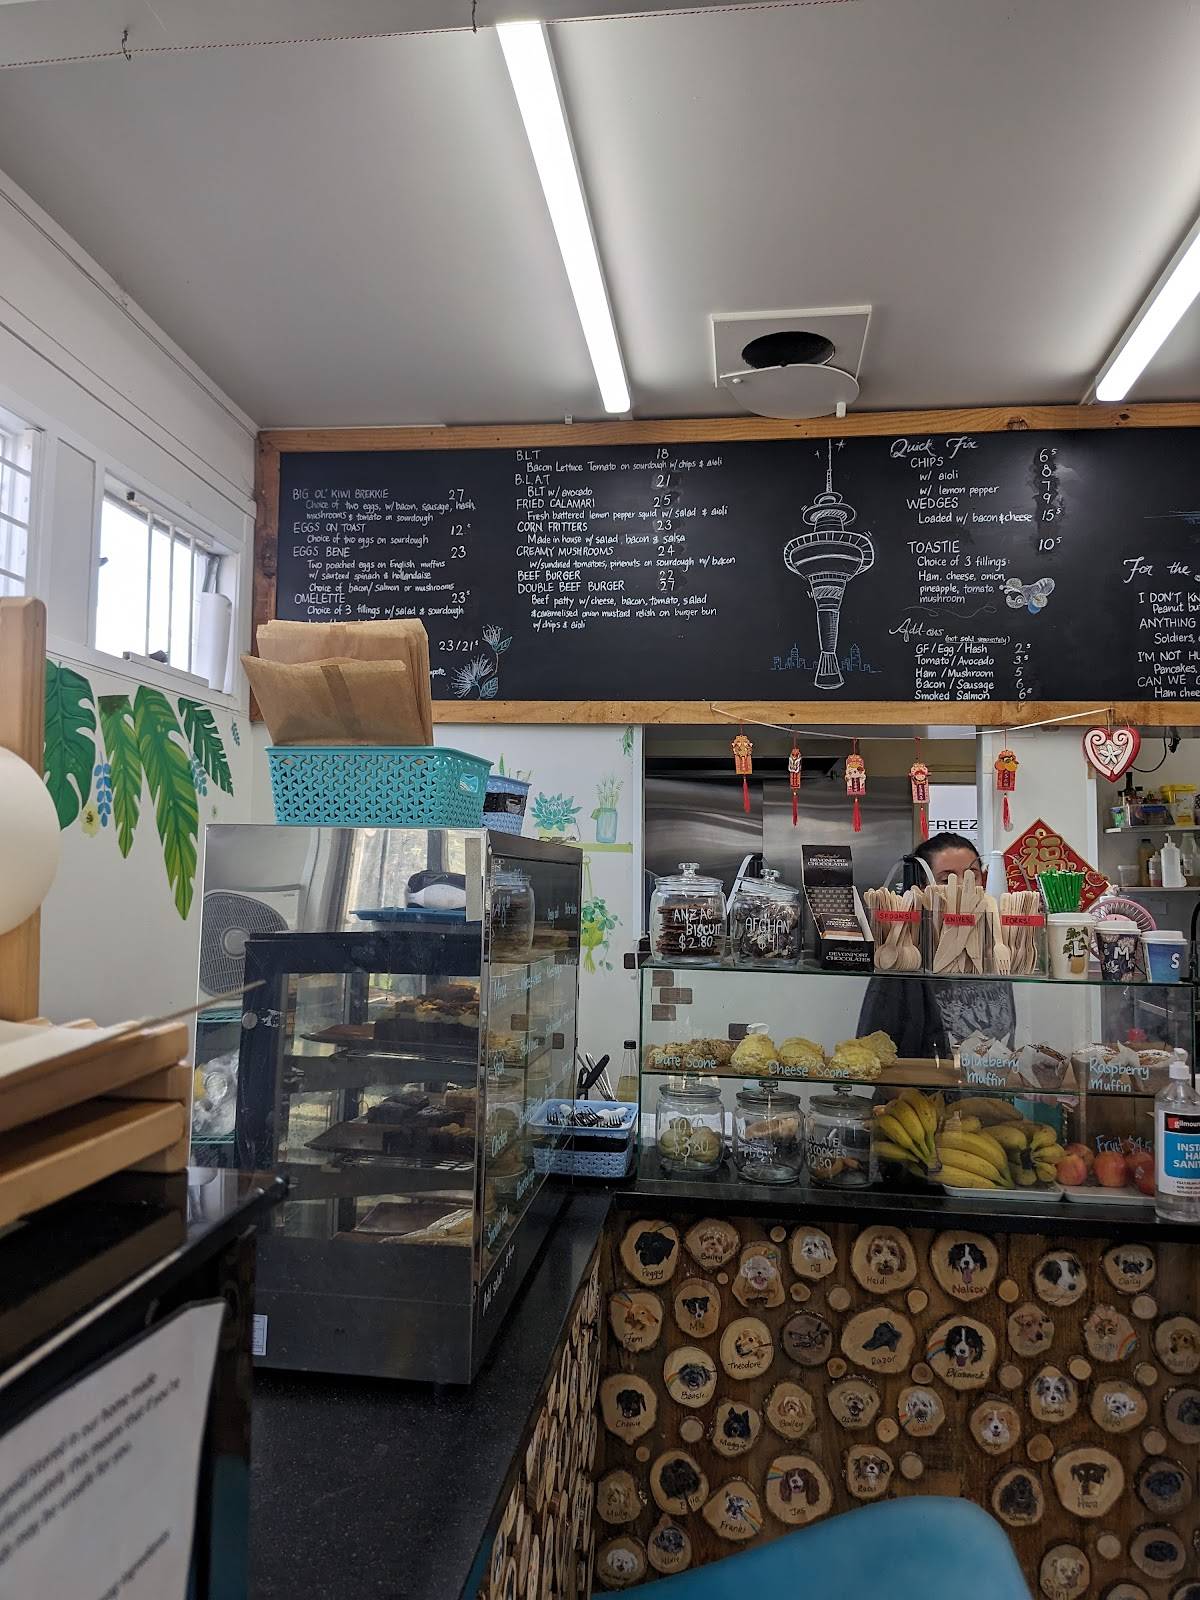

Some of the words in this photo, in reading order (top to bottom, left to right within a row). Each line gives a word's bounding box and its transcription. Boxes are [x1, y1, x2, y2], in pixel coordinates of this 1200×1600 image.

[890, 438, 936, 458] Quick
[946, 436, 979, 459] Fix
[657, 449, 669, 460] 18
[527, 460, 552, 473] Bacon
[556, 460, 583, 472] Lettuce
[588, 461, 616, 471] Tomato
[633, 459, 667, 471] sourdough
[707, 457, 723, 467] aioli
[910, 456, 944, 468] CHIPS
[919, 471, 931, 481] w/
[939, 470, 958, 480] aioli
[1041, 465, 1052, 477] 8
[657, 475, 670, 488] 21
[293, 489, 308, 500] BIG
[332, 490, 350, 498] KIWI
[355, 489, 388, 498] BREKKIE
[449, 489, 464, 502] 27
[528, 486, 545, 497] BLT
[920, 485, 932, 496] w/
[939, 484, 966, 494] lemon
[969, 485, 1000, 498] pepper
[1041, 481, 1051, 491] 7
[306, 500, 328, 509] Choice
[345, 502, 358, 510] two
[517, 499, 544, 510] FRIED
[550, 499, 595, 508] CALAMARI
[654, 494, 671, 508] 25
[907, 497, 958, 510] WEDGES
[1043, 492, 1051, 504] 9
[307, 511, 346, 520] mushrooms
[357, 512, 381, 521] tomato
[397, 514, 433, 526] sourdough
[527, 511, 550, 520] Fresh
[552, 509, 584, 520] battered
[589, 510, 609, 519] lemon
[613, 511, 635, 521] pepper
[638, 508, 657, 520] squid
[675, 508, 696, 518] salad
[711, 506, 728, 516] aioli
[918, 512, 952, 524] Loaded
[956, 513, 968, 525] w/
[293, 522, 319, 533] EGGS
[326, 523, 337, 532] ON
[341, 523, 365, 533] TOAST
[517, 522, 544, 532] CORN
[549, 521, 588, 532] FRITTERS
[657, 519, 672, 531] 23
[307, 535, 330, 544] Choice
[358, 537, 374, 549] eggs
[391, 534, 428, 548] sourdough
[527, 534, 550, 544] Made
[562, 534, 582, 543] house
[625, 534, 650, 544] bacon
[663, 534, 685, 544] salsa
[293, 546, 318, 557] EGGS
[326, 547, 350, 558] BENE
[451, 546, 466, 558] 23
[517, 546, 555, 556] CREAMY
[558, 547, 614, 556] MUSHROOMS
[658, 546, 675, 557] 24
[907, 540, 960, 554] TOASTIE
[308, 560, 322, 569] Two
[326, 560, 355, 572] poached
[359, 562, 375, 572] eggs
[390, 560, 415, 572] English
[421, 560, 445, 568] muffins
[656, 558, 694, 572] sourdough
[712, 556, 735, 566] bacon
[917, 556, 947, 567] Choice
[950, 555, 960, 567] of
[964, 556, 971, 566] 3
[354, 572, 380, 581] spinach
[392, 571, 431, 581] hollandaise
[518, 571, 540, 581] BEEF
[546, 571, 581, 581] BURGER
[660, 570, 674, 581] 22
[946, 570, 976, 581] cheese,
[1123, 556, 1153, 583] For
[1167, 562, 1191, 576] the
[309, 584, 331, 592] Choice
[415, 582, 454, 591] mushrooms
[518, 583, 553, 594] DOUBLE
[559, 582, 581, 592] BEEF
[588, 581, 624, 592] BURGER
[660, 581, 675, 592] 27
[920, 584, 959, 595] pineapple,
[295, 593, 345, 604] OMELETTE
[532, 595, 549, 605] Beef
[554, 598, 574, 608] patty
[683, 594, 707, 604] salad
[919, 594, 965, 604] mushroom
[1138, 592, 1144, 603] I
[1150, 592, 1182, 603] DON'T
[307, 606, 331, 615] Choice
[357, 604, 380, 619] fillings
[428, 606, 464, 619] sourdough
[602, 608, 630, 617] mustard
[636, 608, 655, 618] relish
[659, 608, 670, 616] on
[675, 607, 698, 620] burger
[701, 607, 717, 616] bun
[1152, 602, 1184, 614] Peanut
[1139, 618, 1196, 630] ANYTHING
[960, 635, 974, 643] sold
[1154, 633, 1195, 645] Soldiers,
[1137, 651, 1154, 662] I'M
[1160, 650, 1181, 661] NOT
[916, 668, 936, 678] Ham
[1014, 667, 1023, 677] 5
[1016, 678, 1023, 688] 6
[1137, 676, 1162, 687] CAN
[1167, 674, 1186, 684] WE
[914, 691, 950, 700] Smoked
[956, 691, 990, 700] Salmon
[1155, 687, 1176, 698] Ham
[1020, 834, 1070, 880] 福
[745, 917, 790, 934] AFGHAN
[678, 933, 714, 952] $2.80
[1113, 946, 1130, 960] M
[1170, 952, 1180, 969] S
[686, 1054, 717, 1069] Scone
[1089, 1056, 1149, 1080] Raspberry
[768, 1061, 808, 1077] Cheese
[816, 1064, 849, 1079] Scone
[1096, 1135, 1124, 1153] Fruit
[866, 1276, 887, 1286] Heidi
